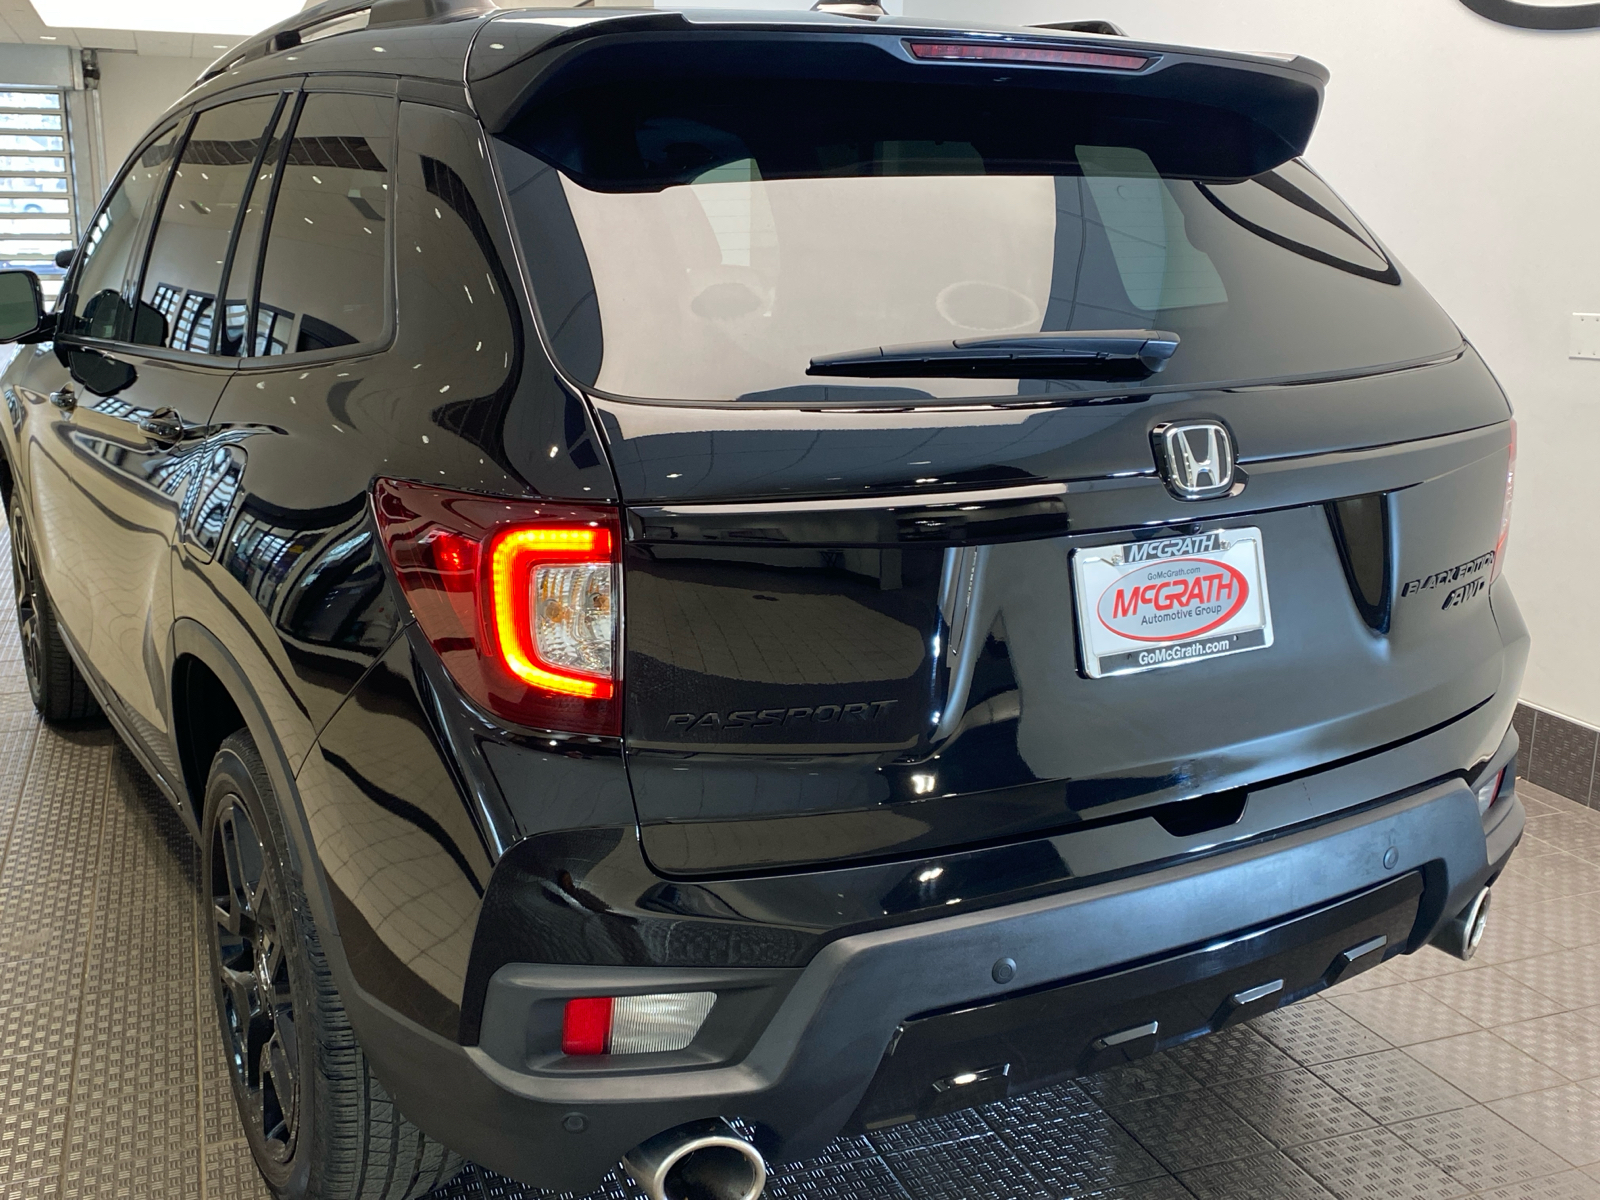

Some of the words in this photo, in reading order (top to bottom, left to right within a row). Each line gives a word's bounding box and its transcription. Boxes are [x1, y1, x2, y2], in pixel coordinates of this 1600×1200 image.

[1147, 566, 1201, 581] GoMcGrath.com
[1141, 608, 1193, 626] Automotive
[1195, 604, 1222, 617] Group
[1138, 639, 1230, 665] GoMcGrath.com
[663, 699, 899, 732] PASSPORT
